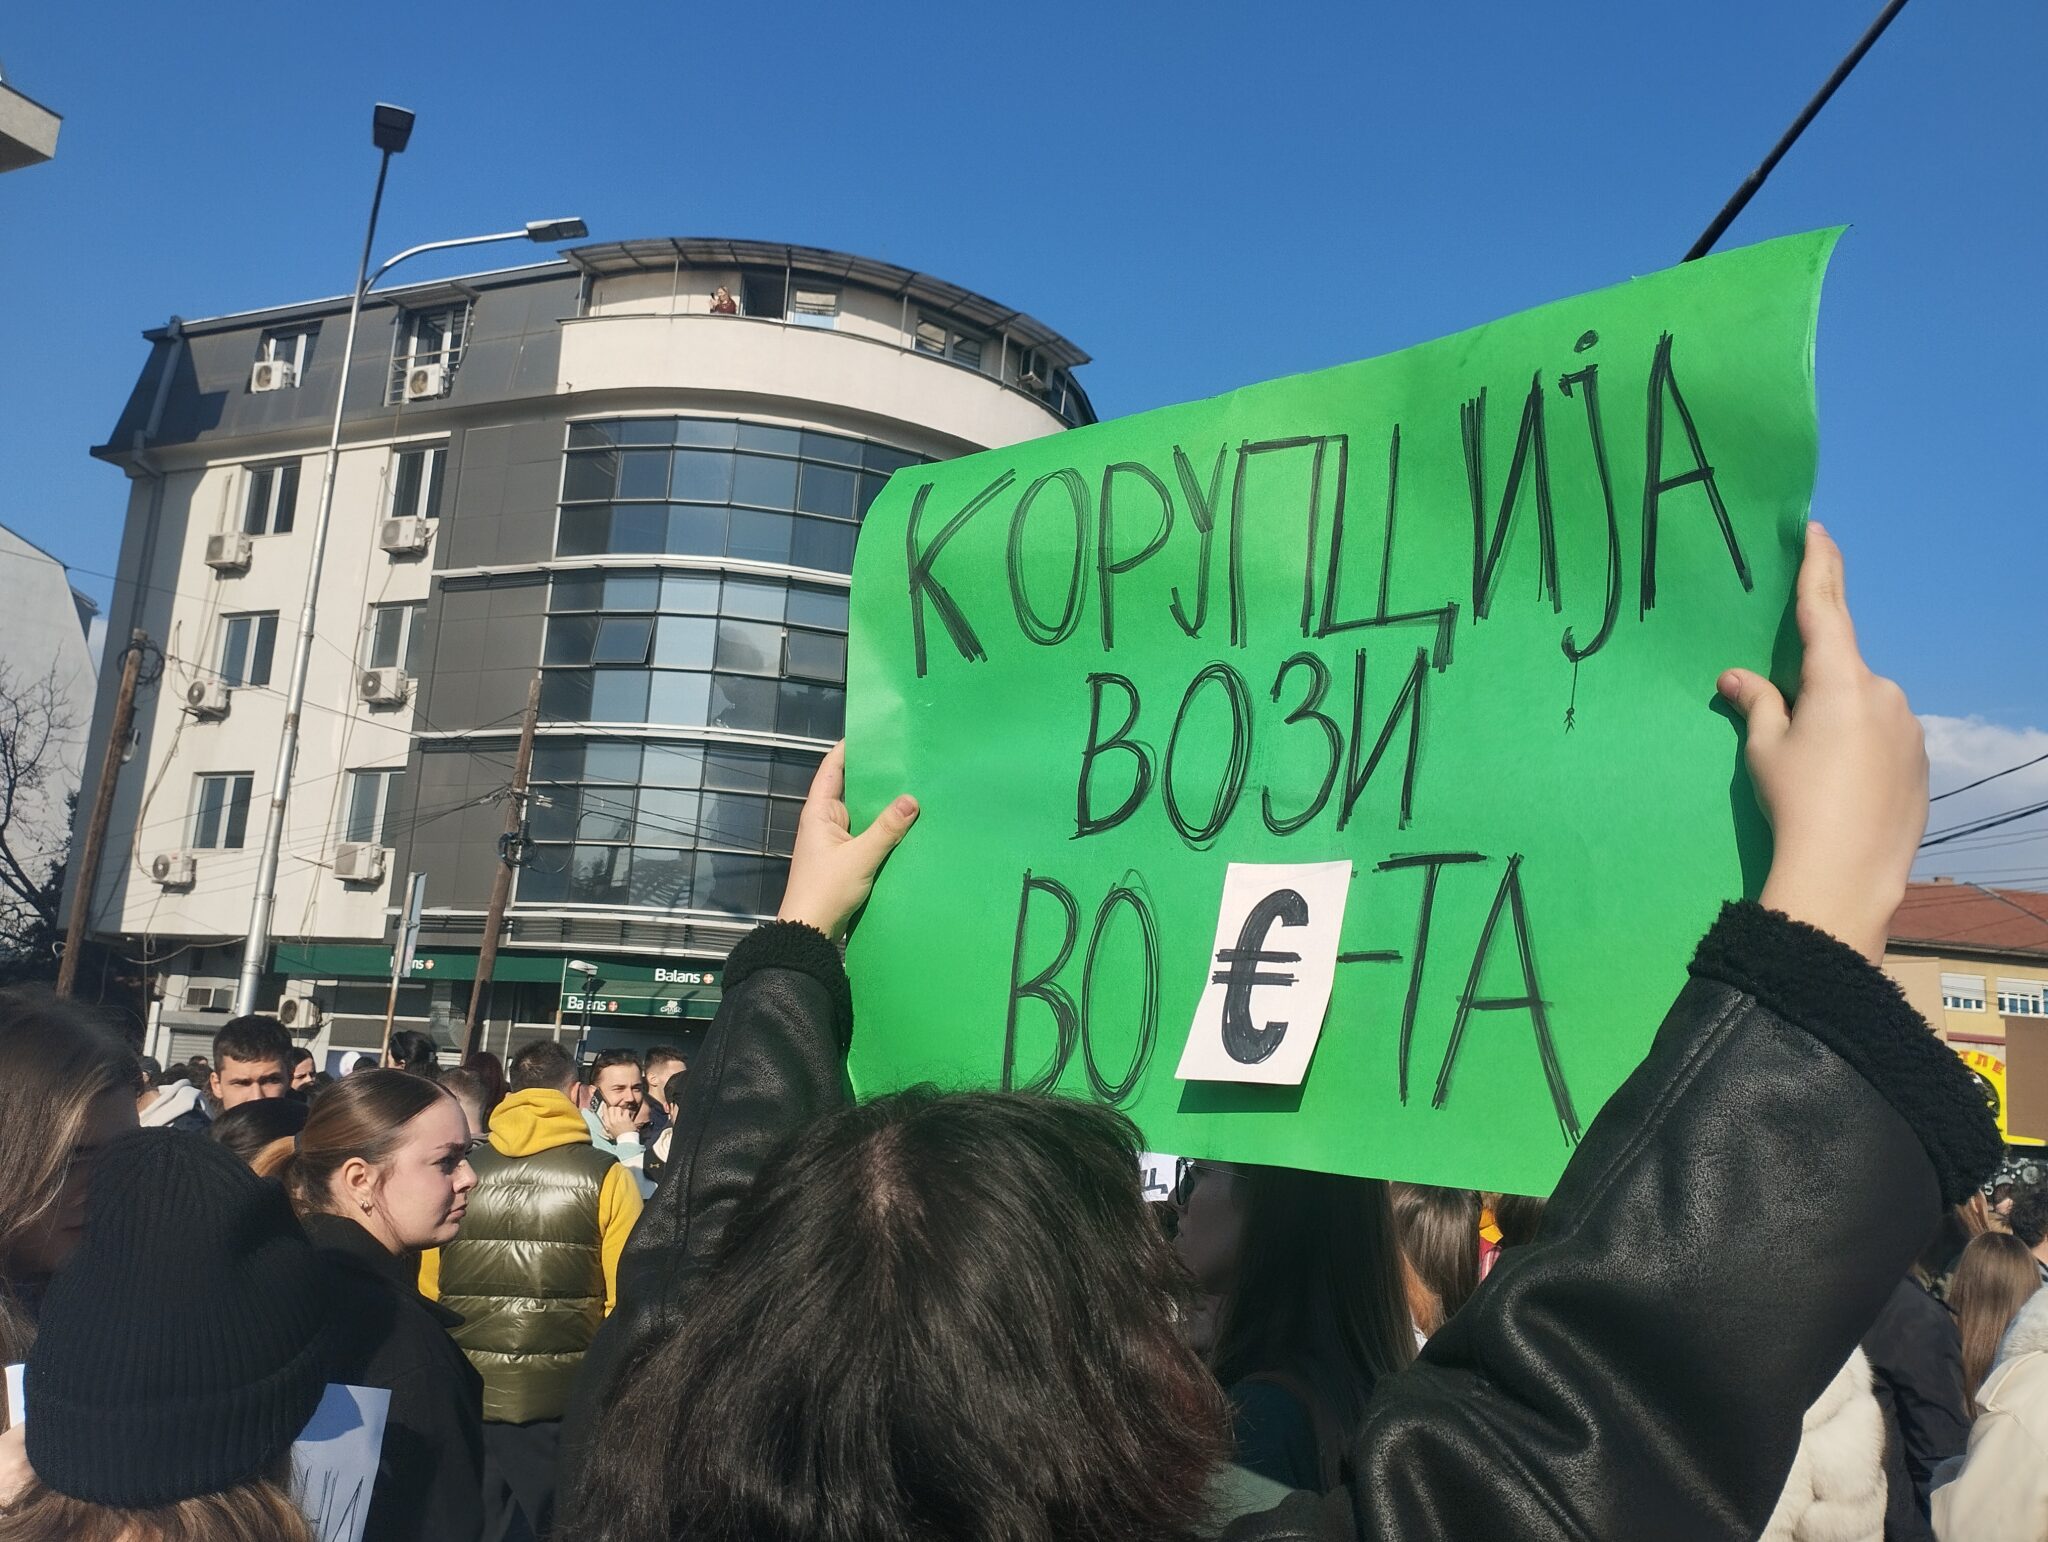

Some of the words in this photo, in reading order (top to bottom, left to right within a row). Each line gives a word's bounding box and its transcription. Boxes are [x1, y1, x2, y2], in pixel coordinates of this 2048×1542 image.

[1070, 648, 1430, 850] ВОЗИ
[654, 968, 701, 984] Balans
[566, 996, 607, 1012] Baans
